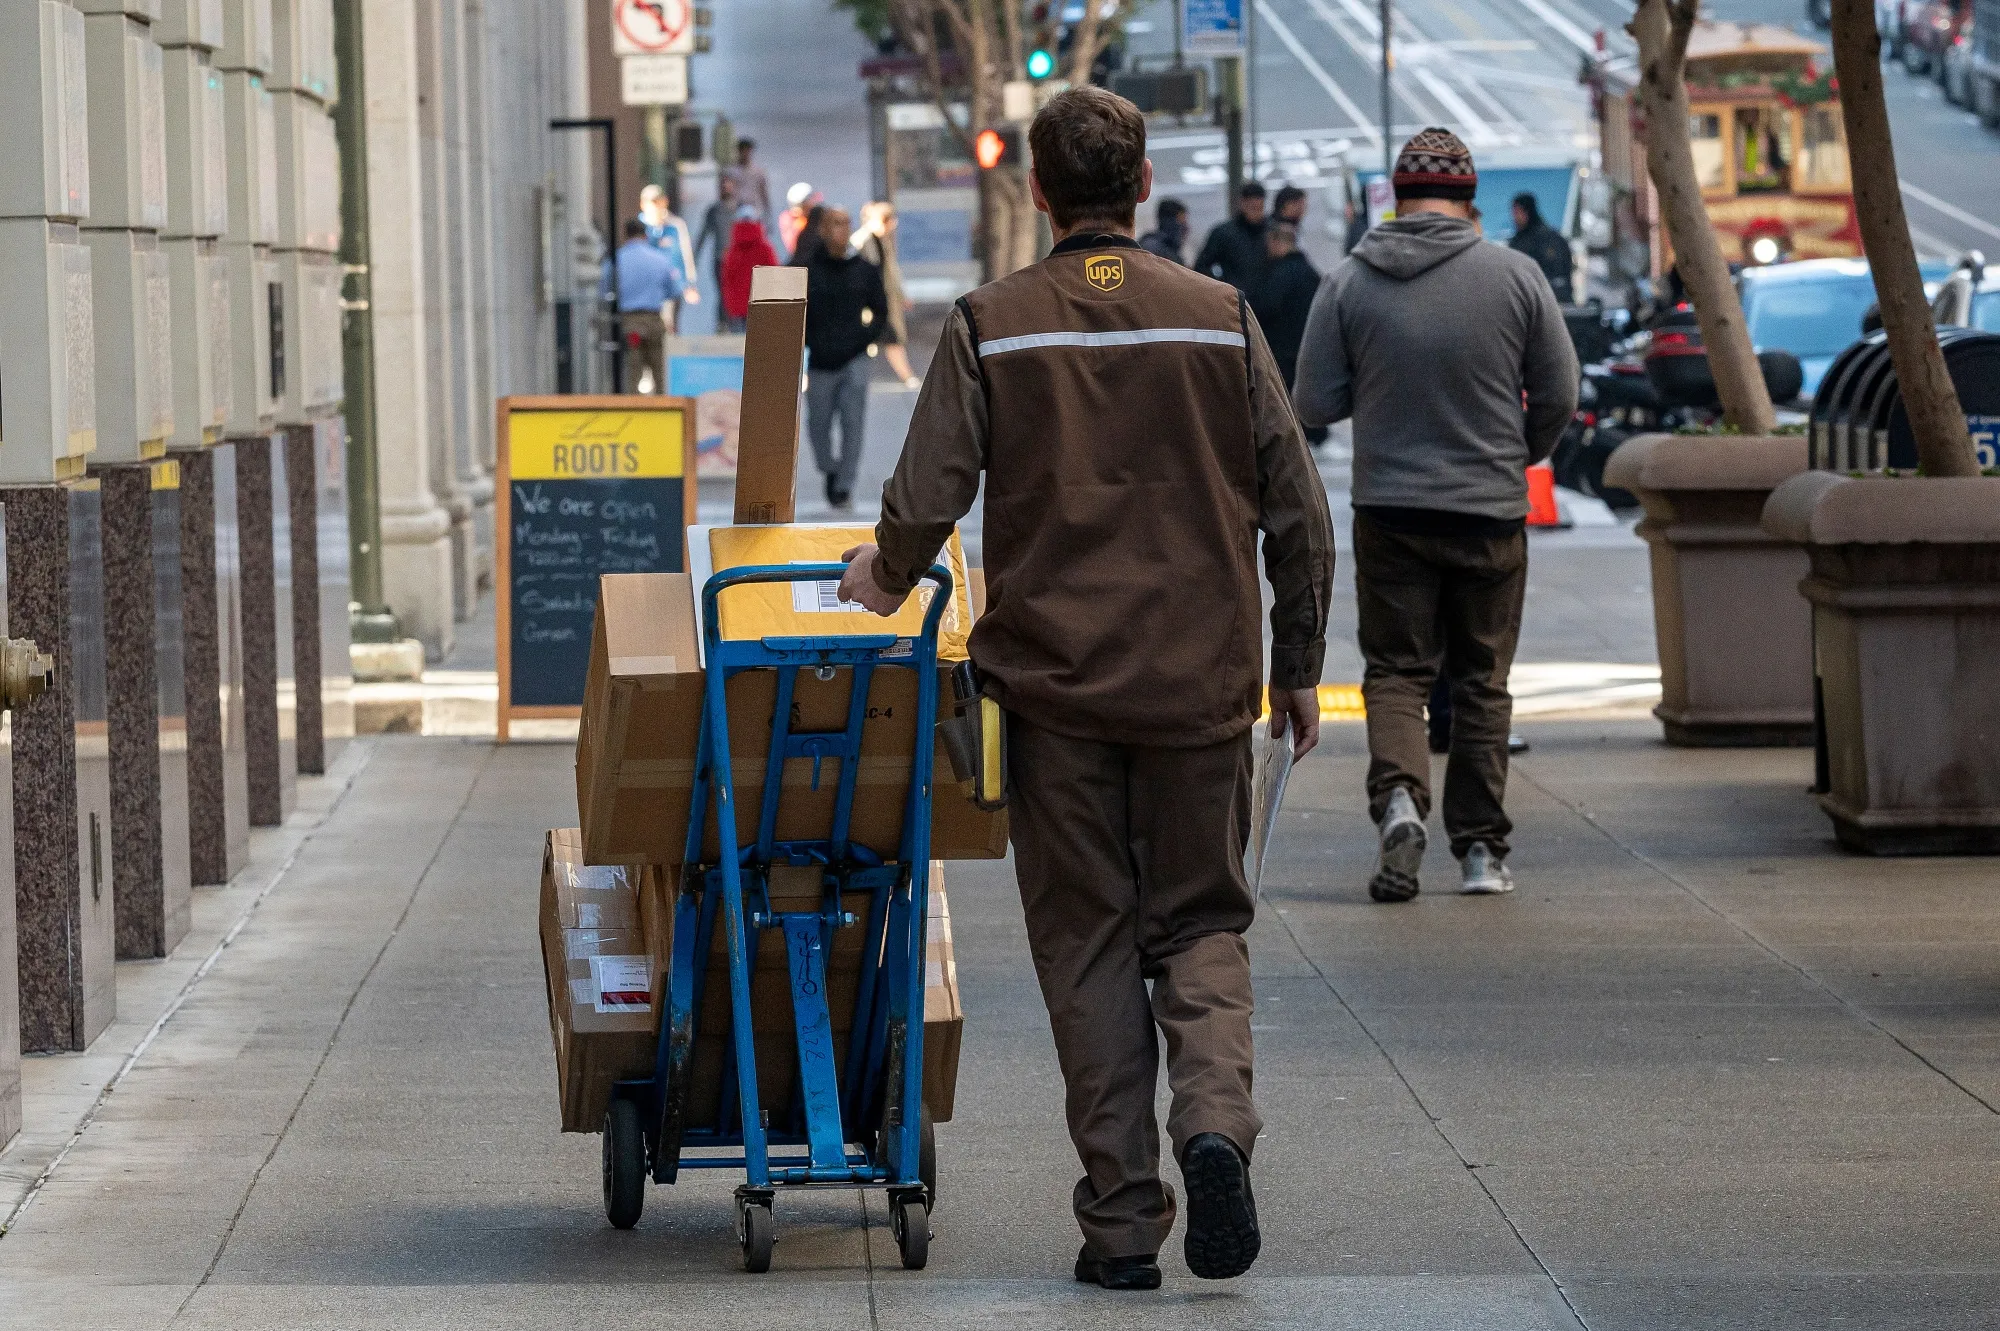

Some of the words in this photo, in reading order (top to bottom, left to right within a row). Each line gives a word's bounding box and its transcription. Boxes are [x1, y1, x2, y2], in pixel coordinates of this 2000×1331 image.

[1089, 265, 1121, 285] ups
[553, 442, 639, 473] ROOTS
[514, 483, 552, 514] We
[558, 497, 595, 517] are
[864, 707, 893, 719] C-4
